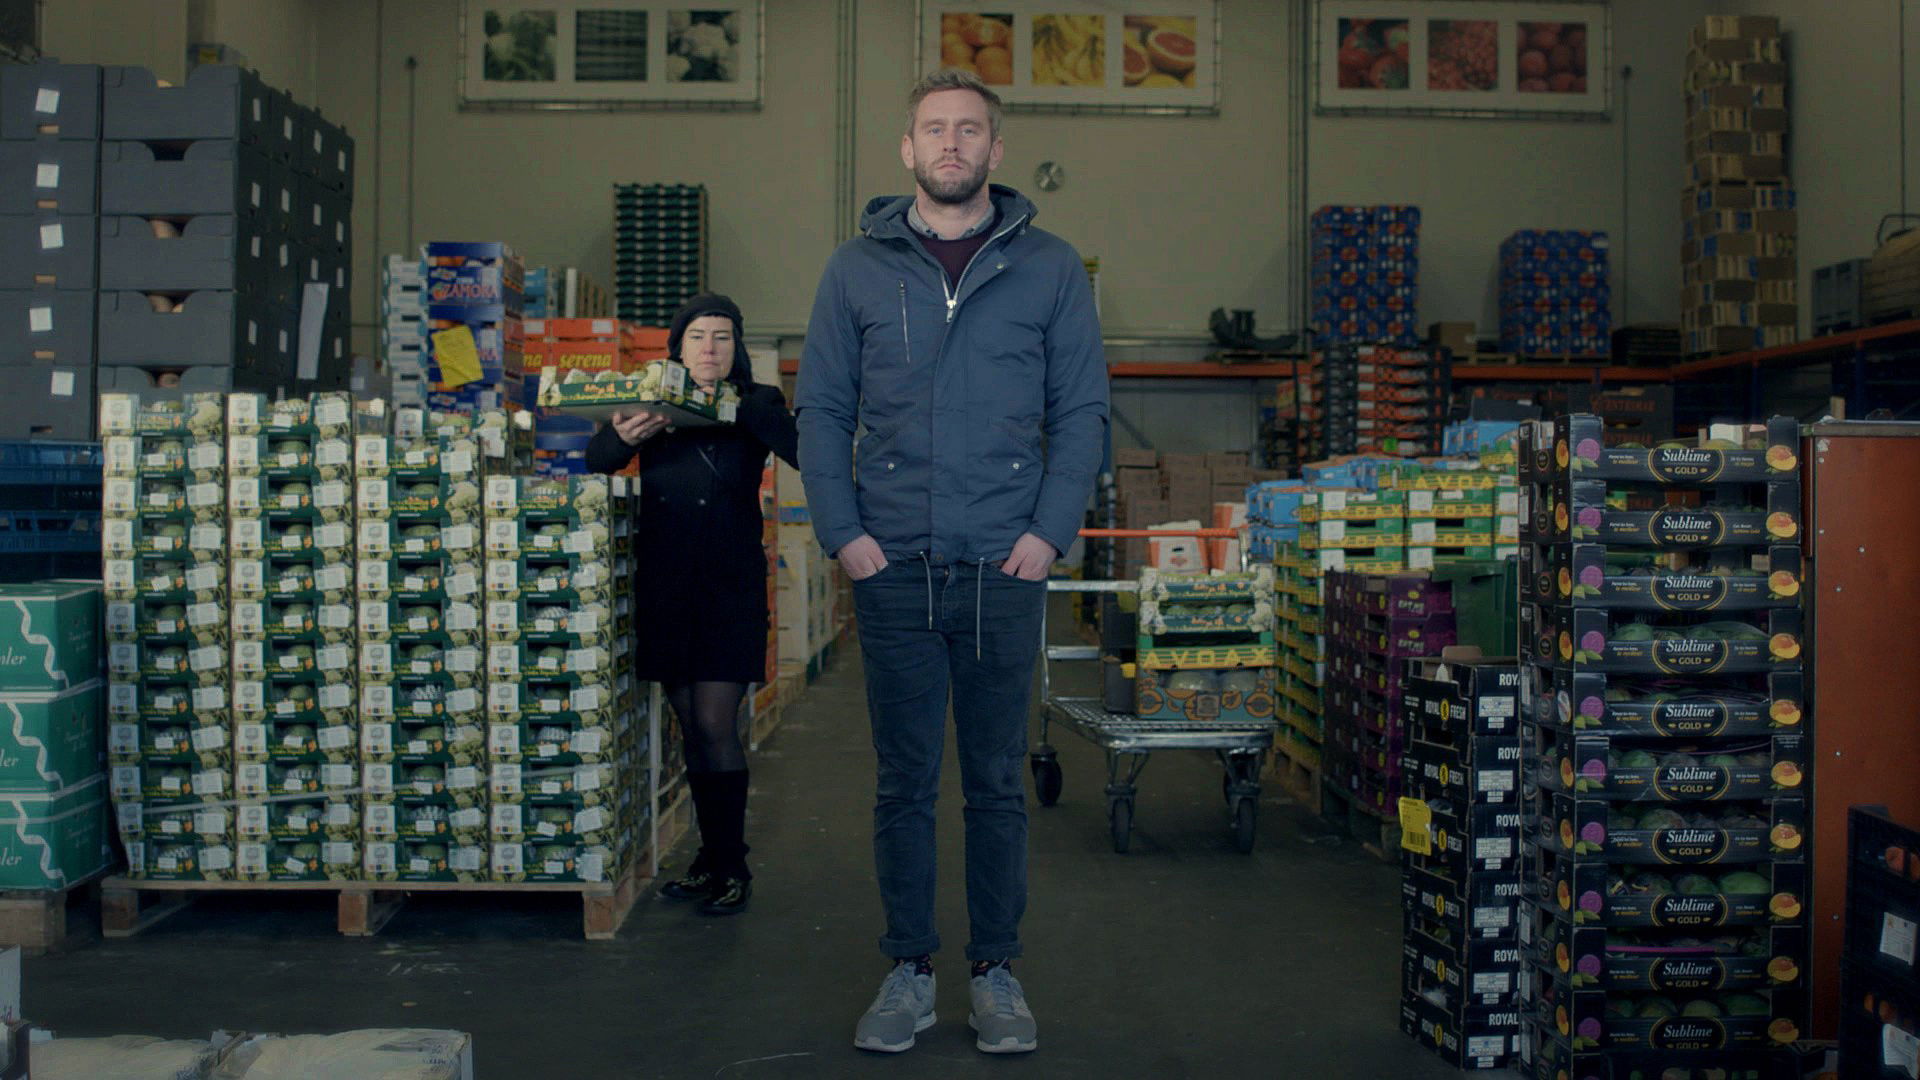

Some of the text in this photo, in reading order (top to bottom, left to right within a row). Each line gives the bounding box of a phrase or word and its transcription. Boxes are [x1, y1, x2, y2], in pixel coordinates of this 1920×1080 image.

[559, 353, 613, 369] serena
[1662, 448, 1711, 462] Sublime
[1674, 466, 1698, 475] GOLD
[1662, 515, 1712, 529] Sublime
[1675, 534, 1698, 542] GOLD
[1664, 575, 1713, 588] Sublime
[1677, 593, 1701, 601] GOLD
[1666, 639, 1714, 652] Sublime
[1678, 656, 1702, 664] GOLD
[1499, 673, 1520, 686] ROY
[1665, 704, 1714, 718] Sublime
[1678, 721, 1701, 730] GOLD
[1667, 766, 1717, 780] Sublime
[1680, 784, 1704, 793] GOLD
[1666, 829, 1715, 843] Sublime
[1678, 847, 1702, 856] GOLD
[1495, 883, 1521, 896] ROYA
[1664, 898, 1714, 912] Sublime
[1677, 916, 1701, 925] GOLD
[1663, 961, 1712, 976] Sublime
[1675, 980, 1699, 988] GOLD
[1489, 1013, 1519, 1026] ROYAL
[1664, 1024, 1713, 1038] Sublime
